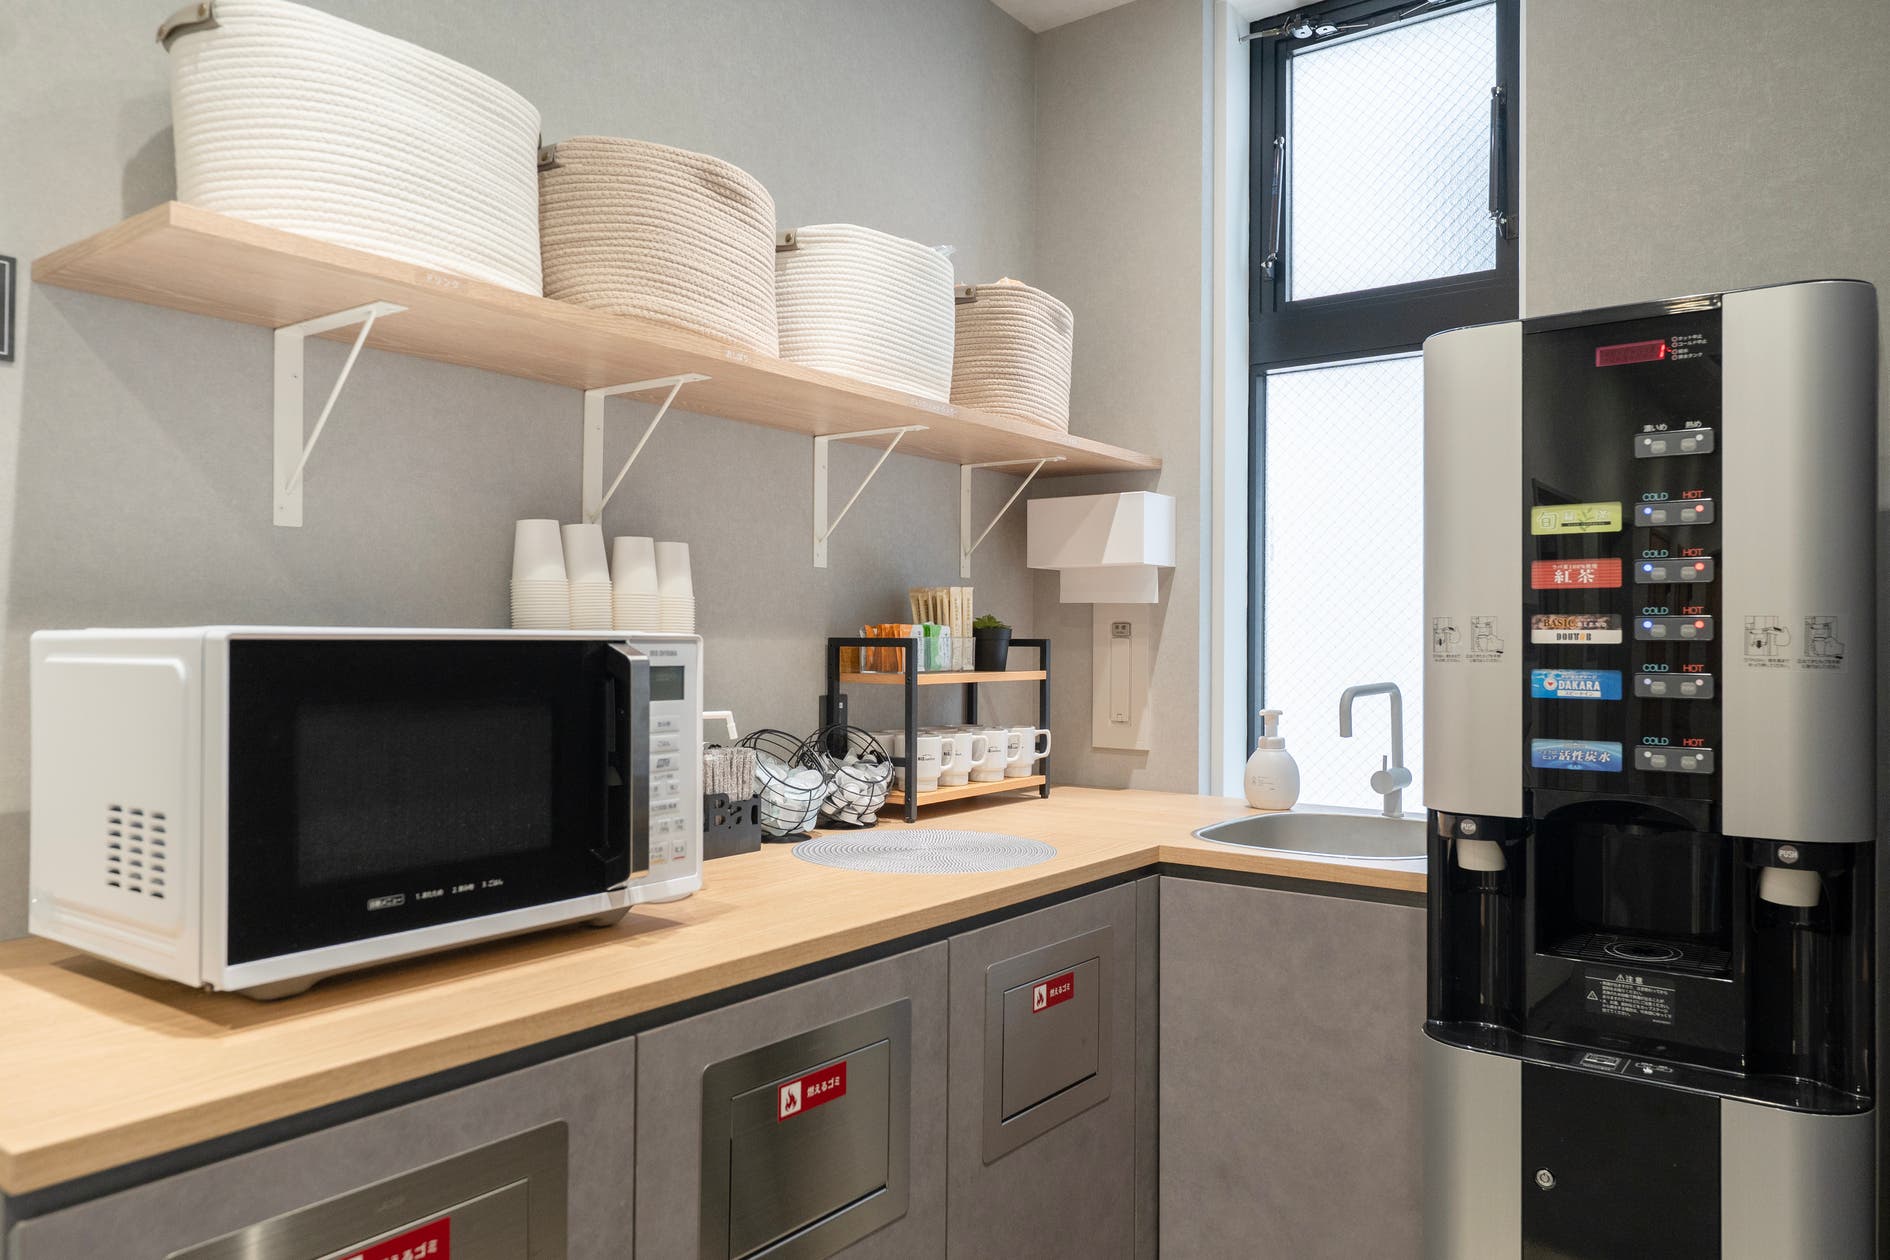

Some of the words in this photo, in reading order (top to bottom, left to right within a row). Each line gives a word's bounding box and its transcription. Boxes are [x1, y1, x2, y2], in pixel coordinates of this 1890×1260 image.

[1642, 492, 1669, 501] COLD
[1682, 490, 1704, 499] HOT
[1642, 550, 1669, 558] COLD
[1682, 548, 1704, 557] HOT
[1554, 569, 1595, 583] 紅茶
[1642, 607, 1669, 615] COLD
[1682, 606, 1704, 615] HOT
[1543, 617, 1577, 628] BASIC
[1556, 632, 1592, 641] DOUTOR
[1642, 663, 1669, 672] COLD
[1682, 664, 1704, 672] HOT
[1558, 680, 1600, 690] DAKARA
[1642, 736, 1669, 745] COLD
[1682, 738, 1704, 747] HOT
[1558, 749, 1612, 763] 活性炭水
[806, 1076, 841, 1098] 燃えるゴミ
[381, 1239, 438, 1260] るゴミ
